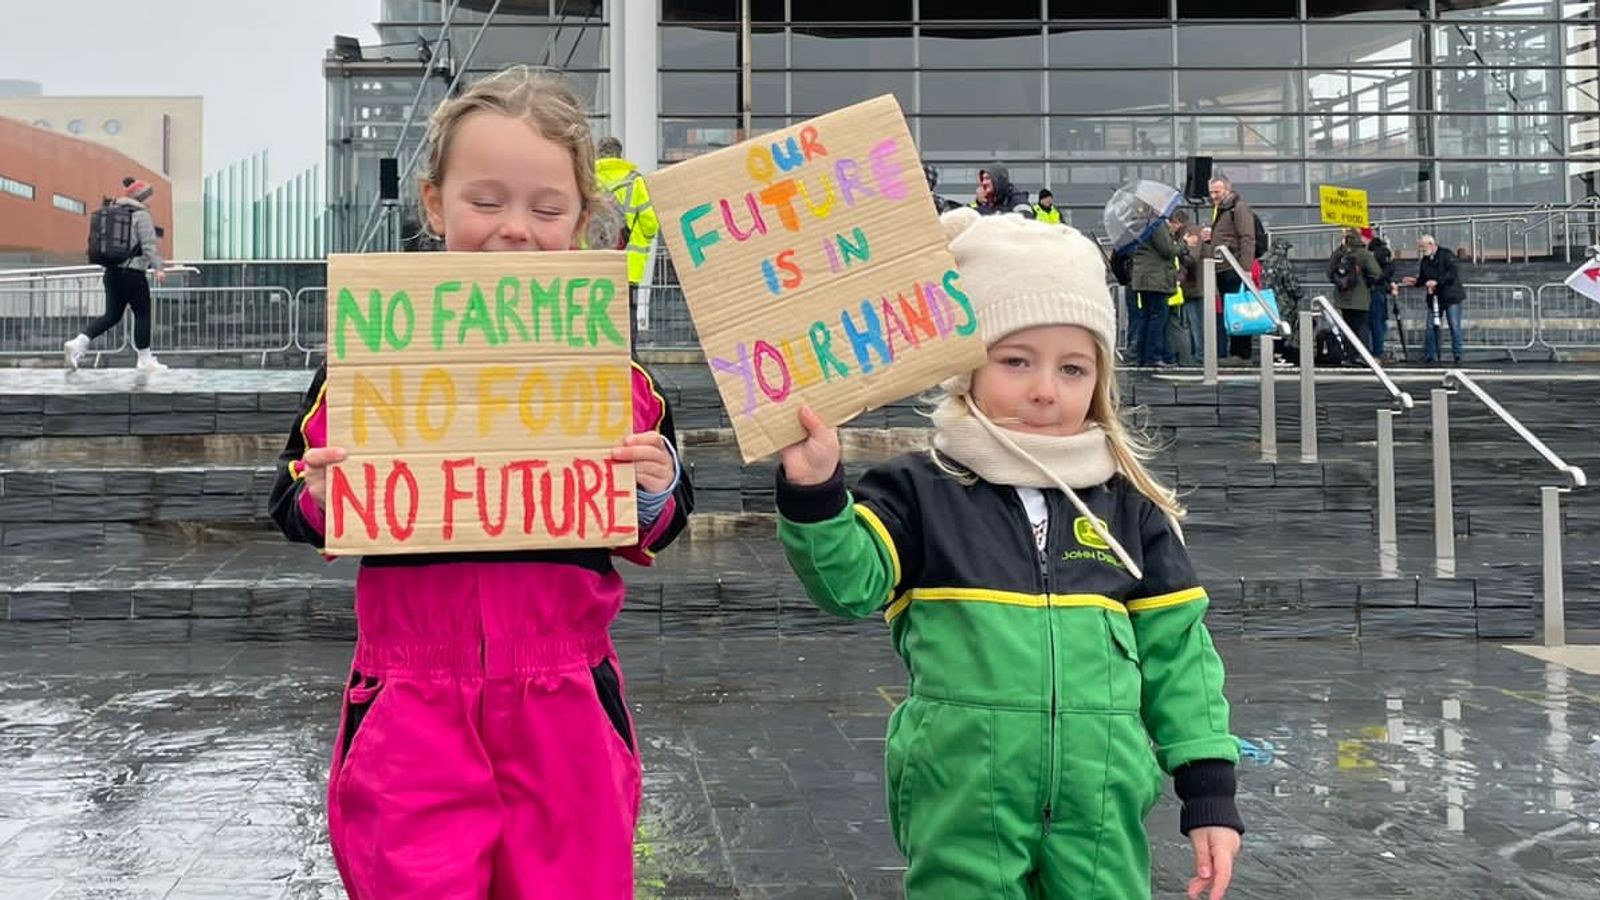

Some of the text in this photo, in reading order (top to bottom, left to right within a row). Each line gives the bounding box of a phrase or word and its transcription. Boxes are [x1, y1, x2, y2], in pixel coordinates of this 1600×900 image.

[747, 126, 827, 182] OUR
[680, 138, 909, 268] FUTURE
[1325, 197, 1363, 209] FARMERS
[1342, 214, 1363, 223] FOOD
[761, 227, 871, 295] IS IN
[334, 276, 627, 360] NO FARMER
[711, 269, 977, 418] YOUR HANDS
[352, 364, 631, 447] NO FOOD
[332, 457, 635, 541] NO FUTURE
